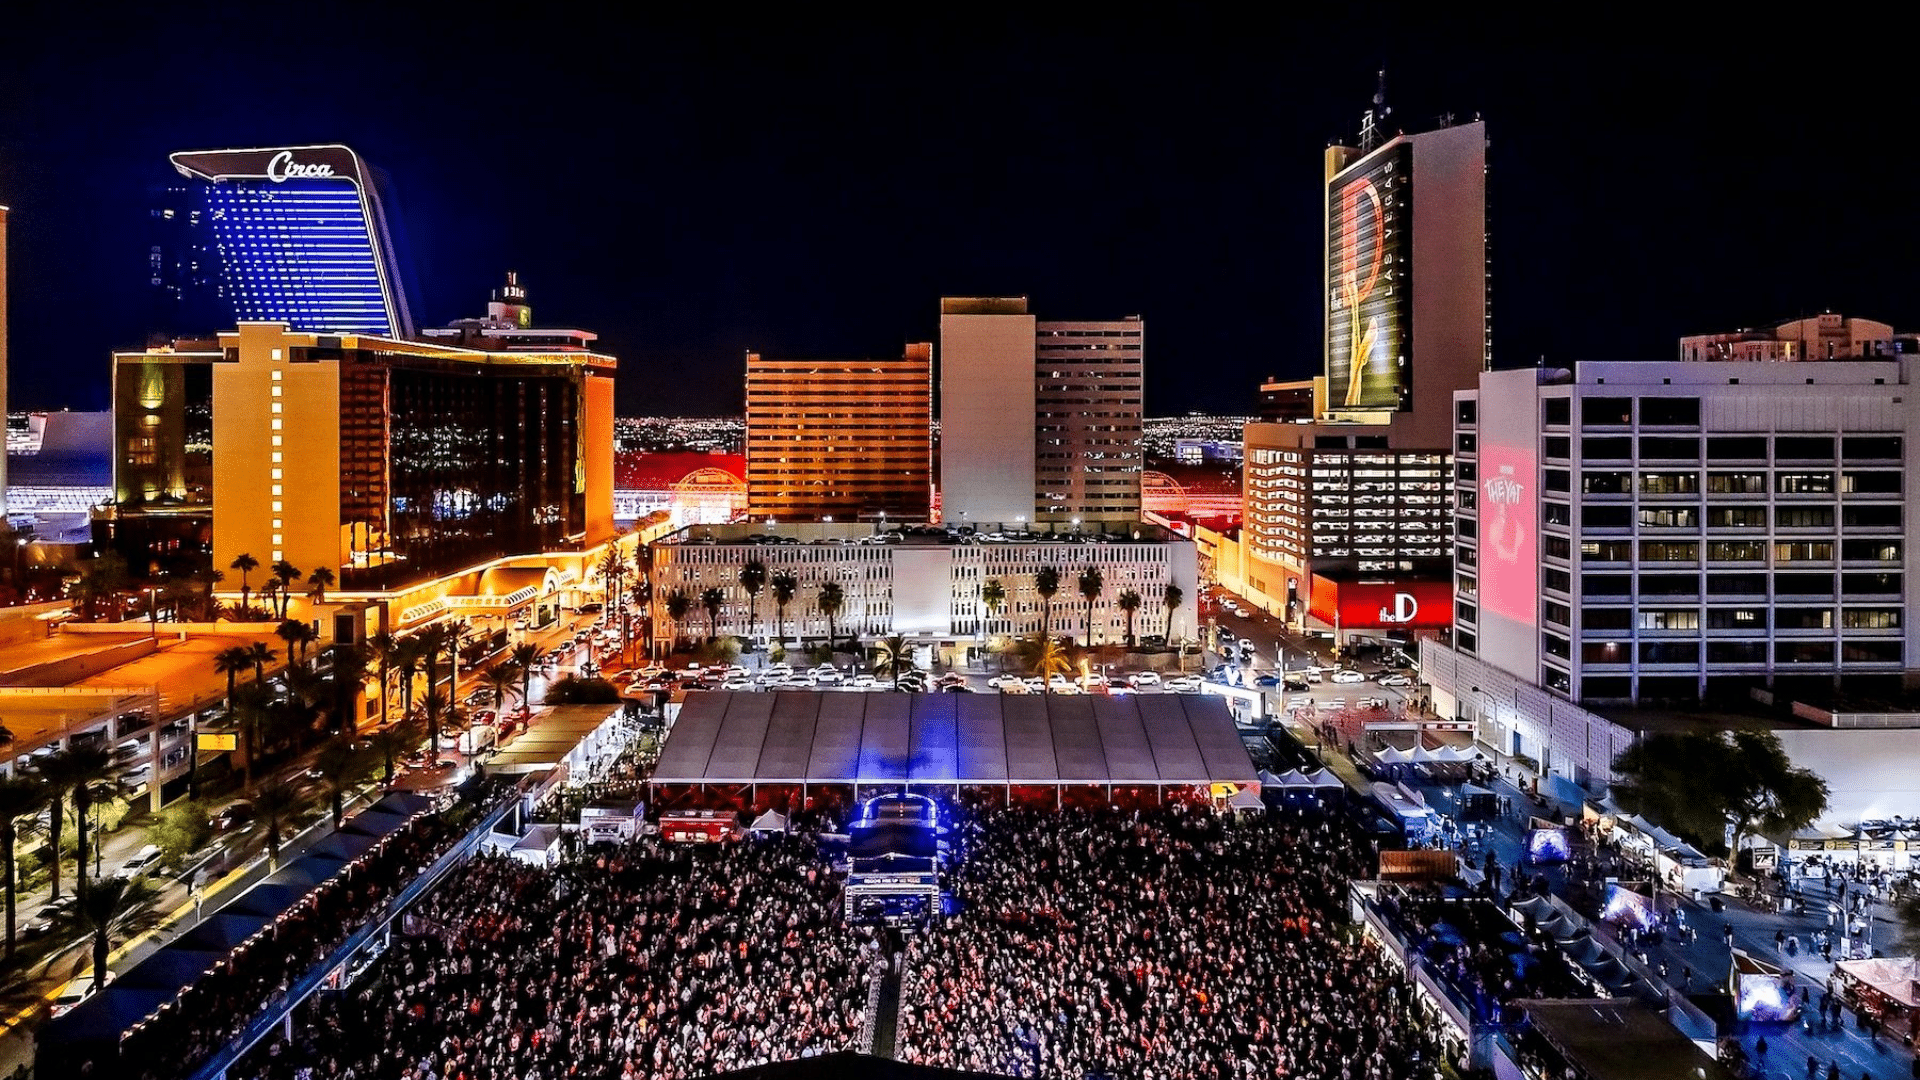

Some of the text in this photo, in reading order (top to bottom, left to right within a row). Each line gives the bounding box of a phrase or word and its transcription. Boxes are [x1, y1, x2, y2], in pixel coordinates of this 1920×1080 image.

[267, 151, 334, 183] Circa
[1383, 161, 1394, 297] LAS VEGAS
[1379, 592, 1418, 622] the D
